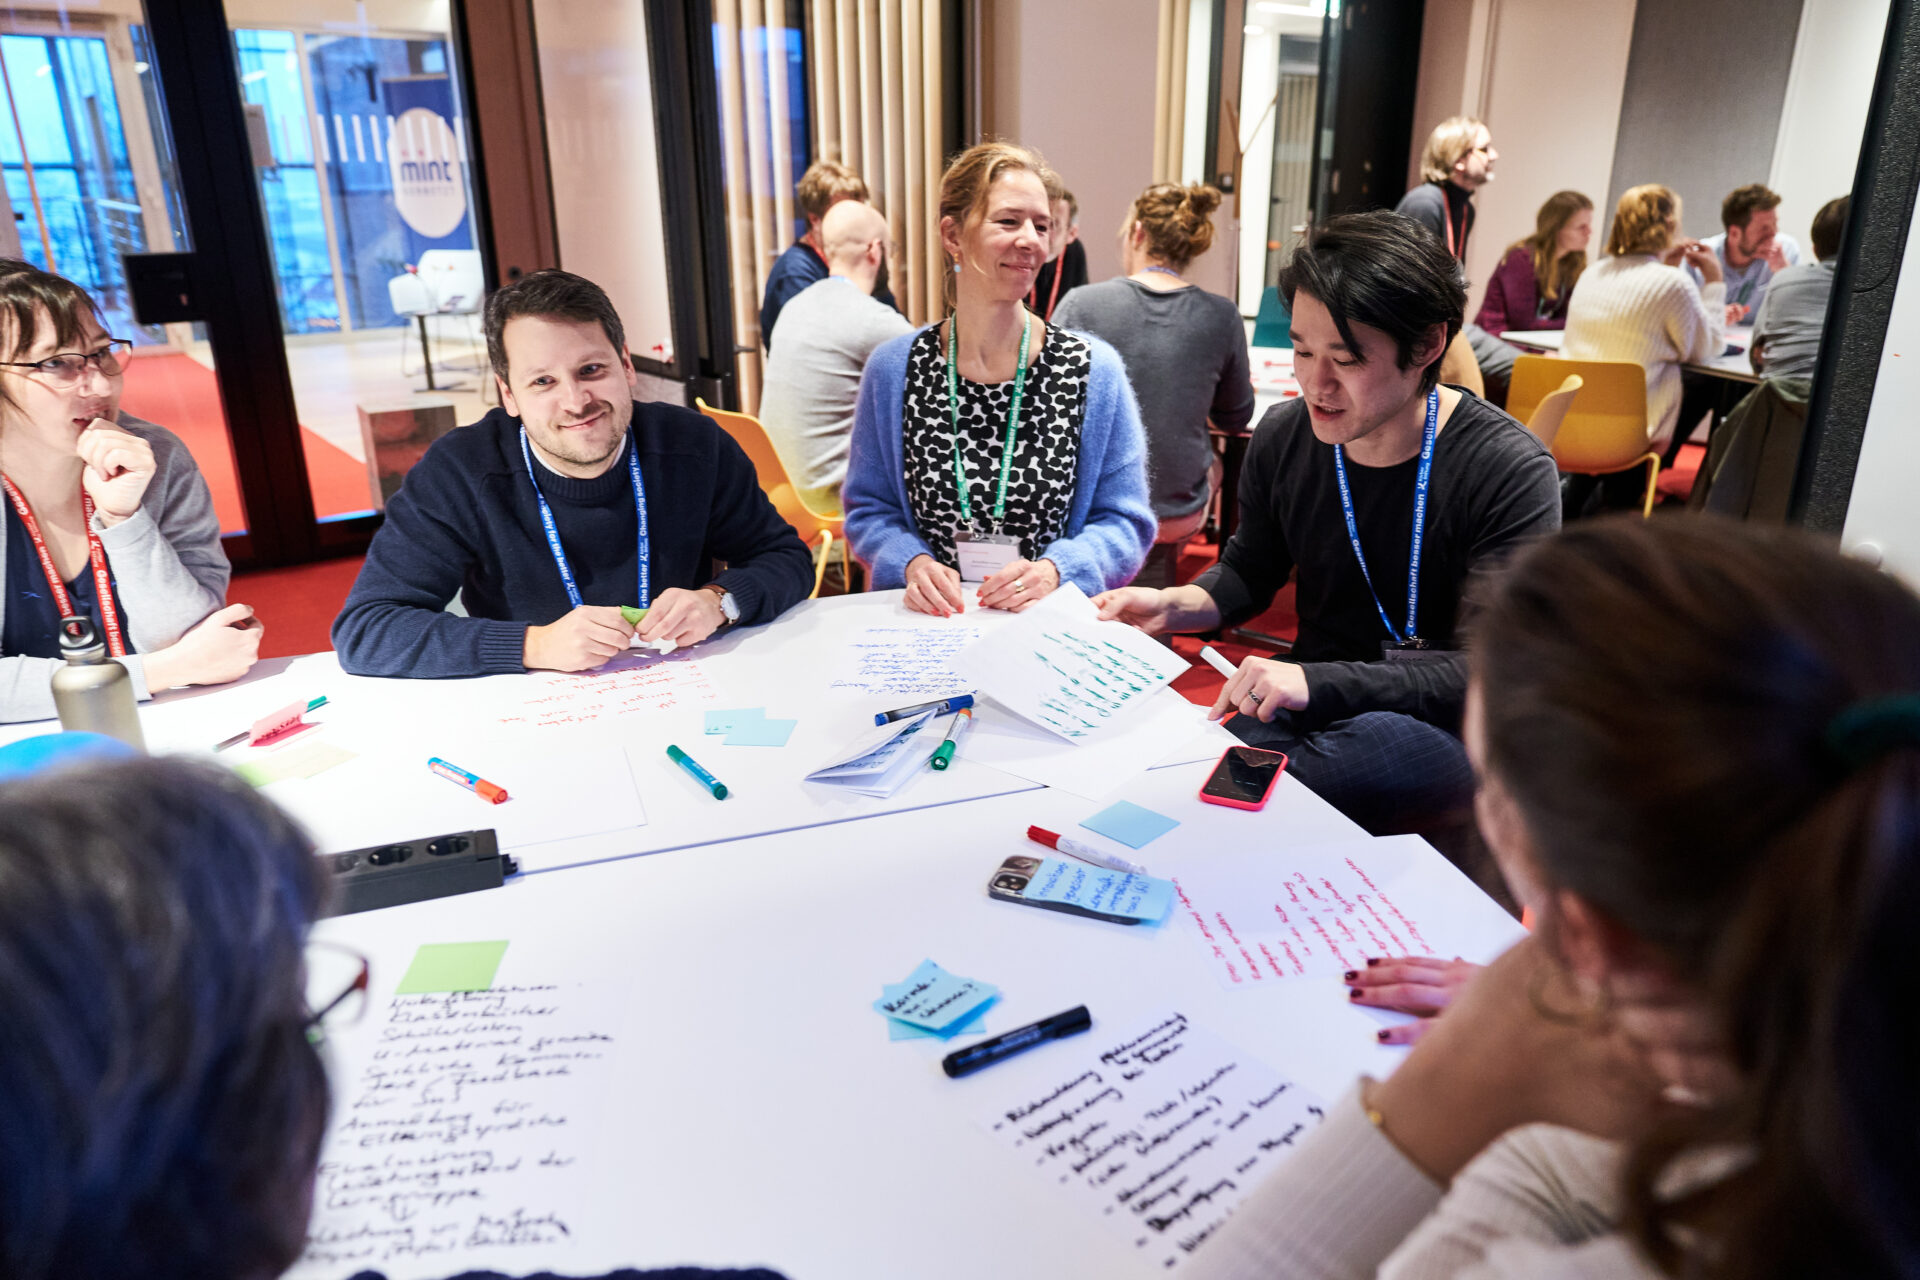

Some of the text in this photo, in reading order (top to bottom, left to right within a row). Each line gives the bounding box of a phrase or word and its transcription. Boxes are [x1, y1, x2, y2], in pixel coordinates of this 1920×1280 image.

[401, 151, 452, 181] mint
[1009, 395, 1020, 426] machen
[1421, 395, 1438, 459] Gesellschaft
[1005, 427, 1015, 454] besser
[632, 466, 643, 496] society
[997, 455, 1011, 505] Gesellschaft
[1333, 444, 1350, 507] esser machen
[637, 497, 646, 535] Changing
[551, 542, 562, 556] the
[556, 556, 571, 580] better
[1408, 493, 1425, 627] Gesellschaft besser machen
[38, 545, 71, 615] besser machen
[96, 569, 115, 630] Gesellschaft
